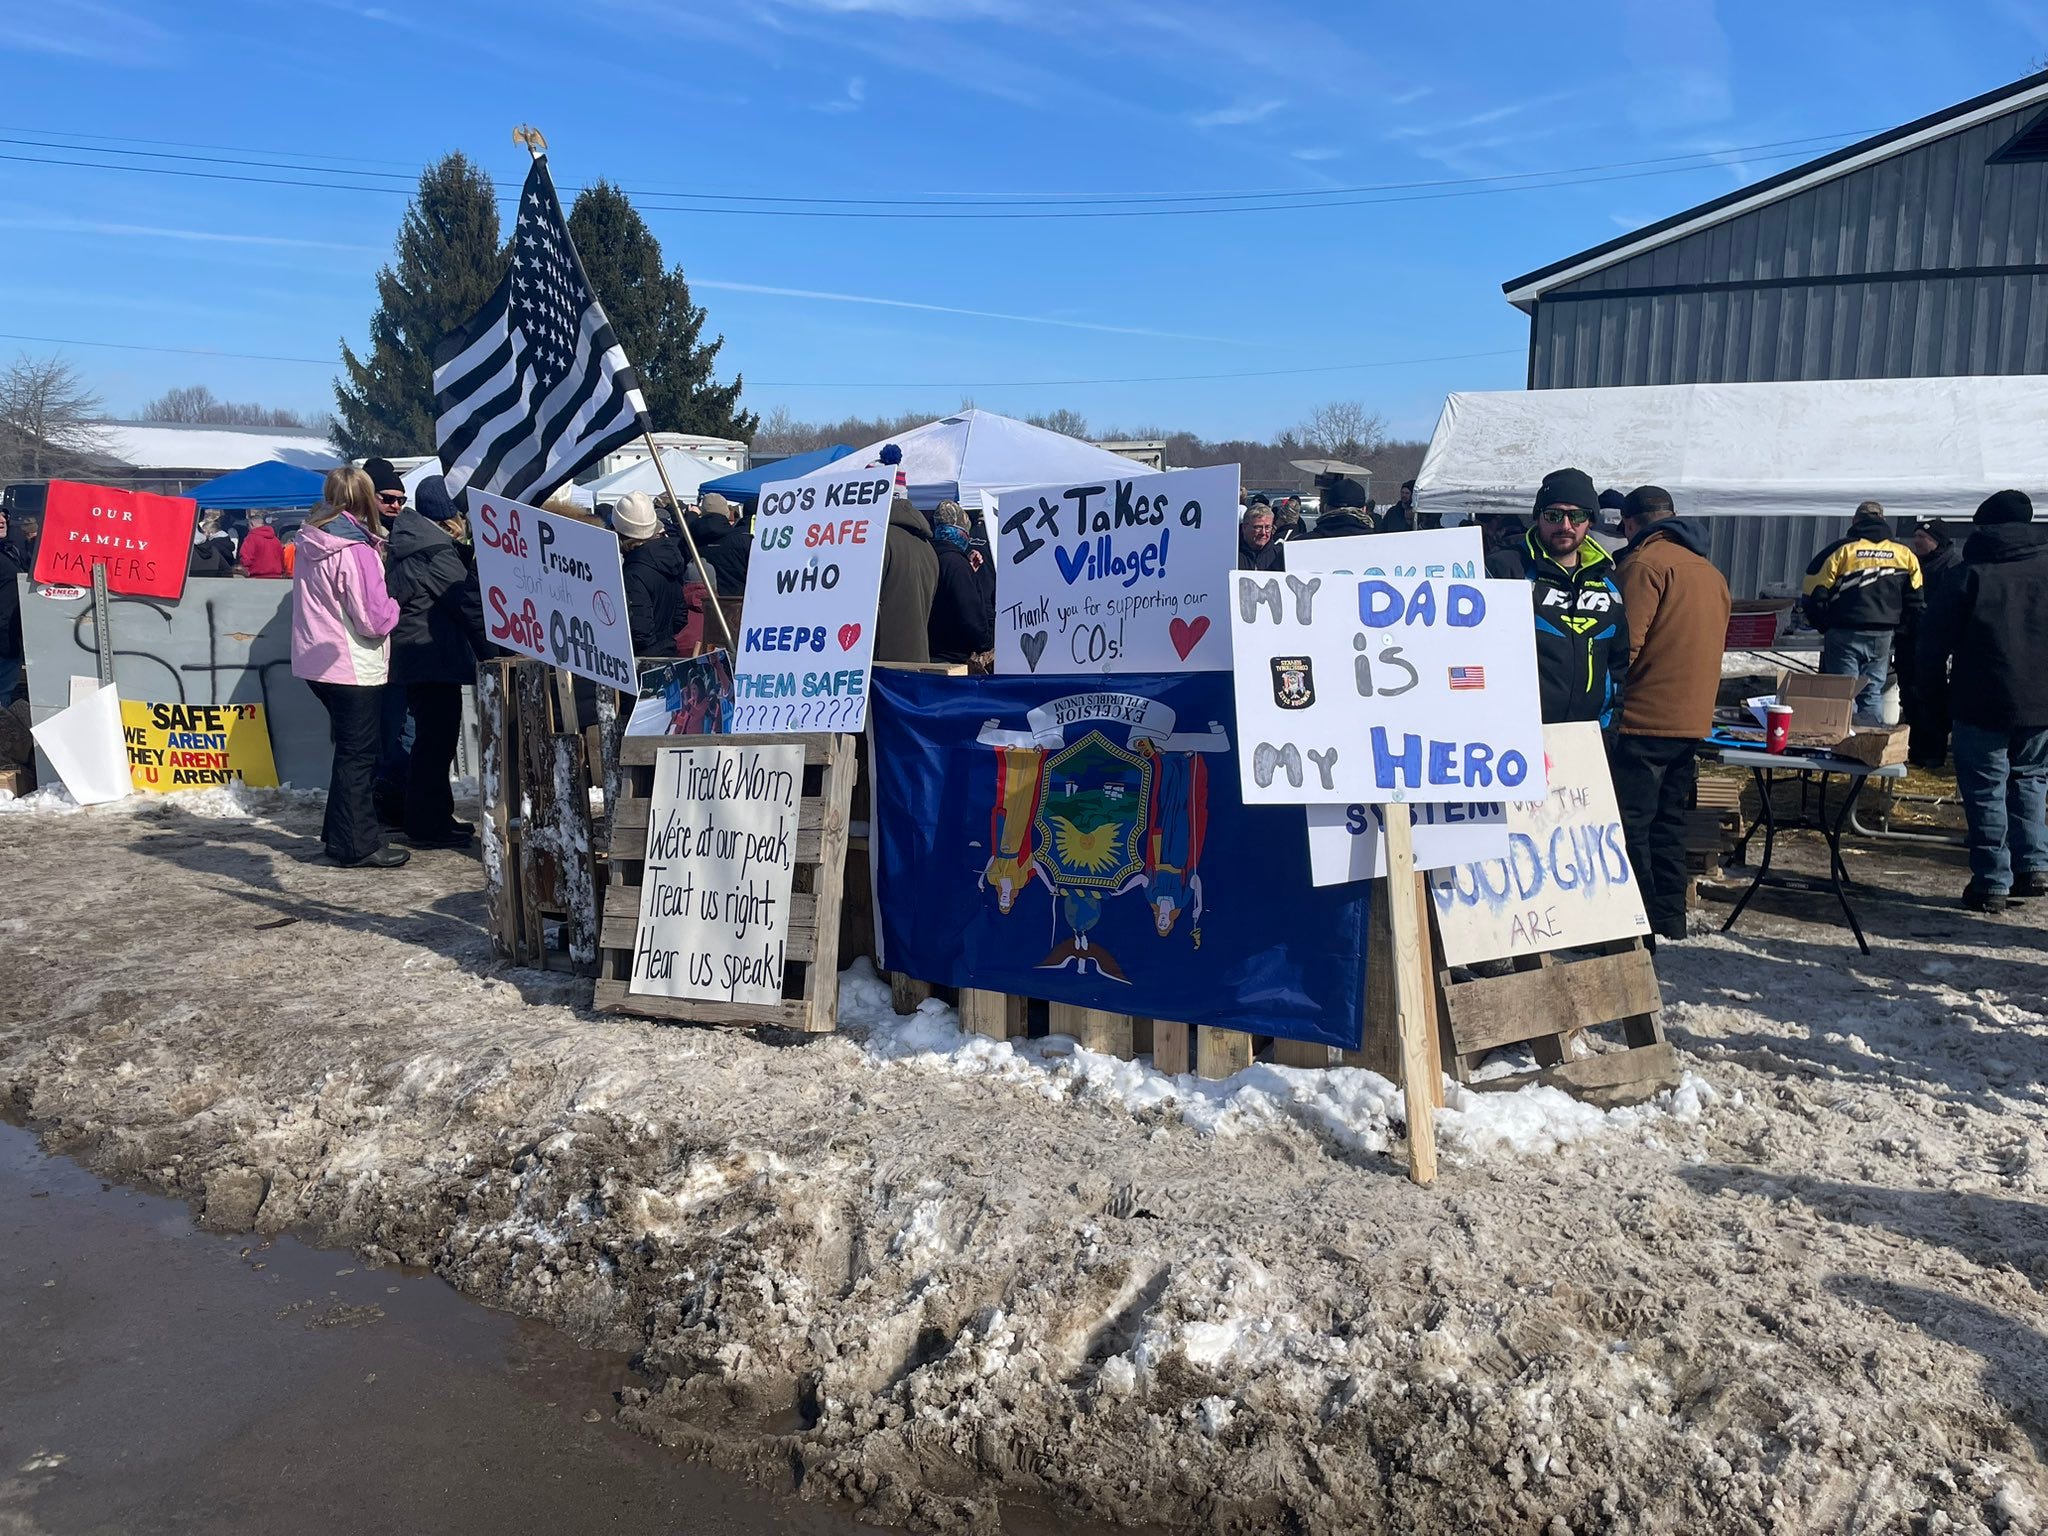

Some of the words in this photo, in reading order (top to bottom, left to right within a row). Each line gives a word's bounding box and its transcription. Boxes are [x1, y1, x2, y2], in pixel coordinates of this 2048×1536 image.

[762, 487, 816, 516] CO'S
[825, 479, 890, 507] KEEP
[92, 507, 133, 522] OUR
[1180, 500, 1203, 529] a
[69, 531, 149, 551] FAMILY
[481, 503, 528, 558] Safe
[537, 520, 593, 582] Prisons
[760, 525, 794, 551] US
[804, 520, 869, 548] SAFE
[52, 552, 156, 582] MATTERS
[1054, 527, 1170, 588] Village!
[776, 563, 840, 595] WHO
[1057, 605, 1079, 634] you
[1084, 595, 1101, 616] for
[1106, 590, 1179, 620] supporting
[1183, 593, 1208, 607] our
[1238, 574, 1322, 626] MY
[1357, 580, 1487, 628] DAD
[488, 586, 545, 653] Safe
[549, 609, 630, 684] Officers
[745, 626, 827, 652] KEEPS
[734, 672, 797, 699] THEM
[801, 669, 864, 698] SAFE
[1054, 694, 1086, 713] UNUM
[1055, 704, 1147, 725] EXCELSIOR
[1087, 694, 1143, 707] PLURIBUS
[123, 725, 147, 745] WE
[168, 732, 227, 750] ARENT
[169, 751, 230, 768] ARENT
[1253, 741, 1338, 790] MY
[1370, 725, 1528, 789] HERO
[1552, 786, 1591, 810] THE
[697, 813, 714, 858] at
[716, 829, 744, 860] our
[741, 815, 790, 880] peak,
[1550, 822, 1629, 893] GUYS
[649, 866, 694, 917] Treat
[700, 888, 719, 921] us
[725, 880, 776, 940] right,
[1510, 906, 1562, 948] ARE
[634, 926, 679, 980] Hear
[690, 950, 713, 987] us
[720, 939, 785, 1003] speak!
